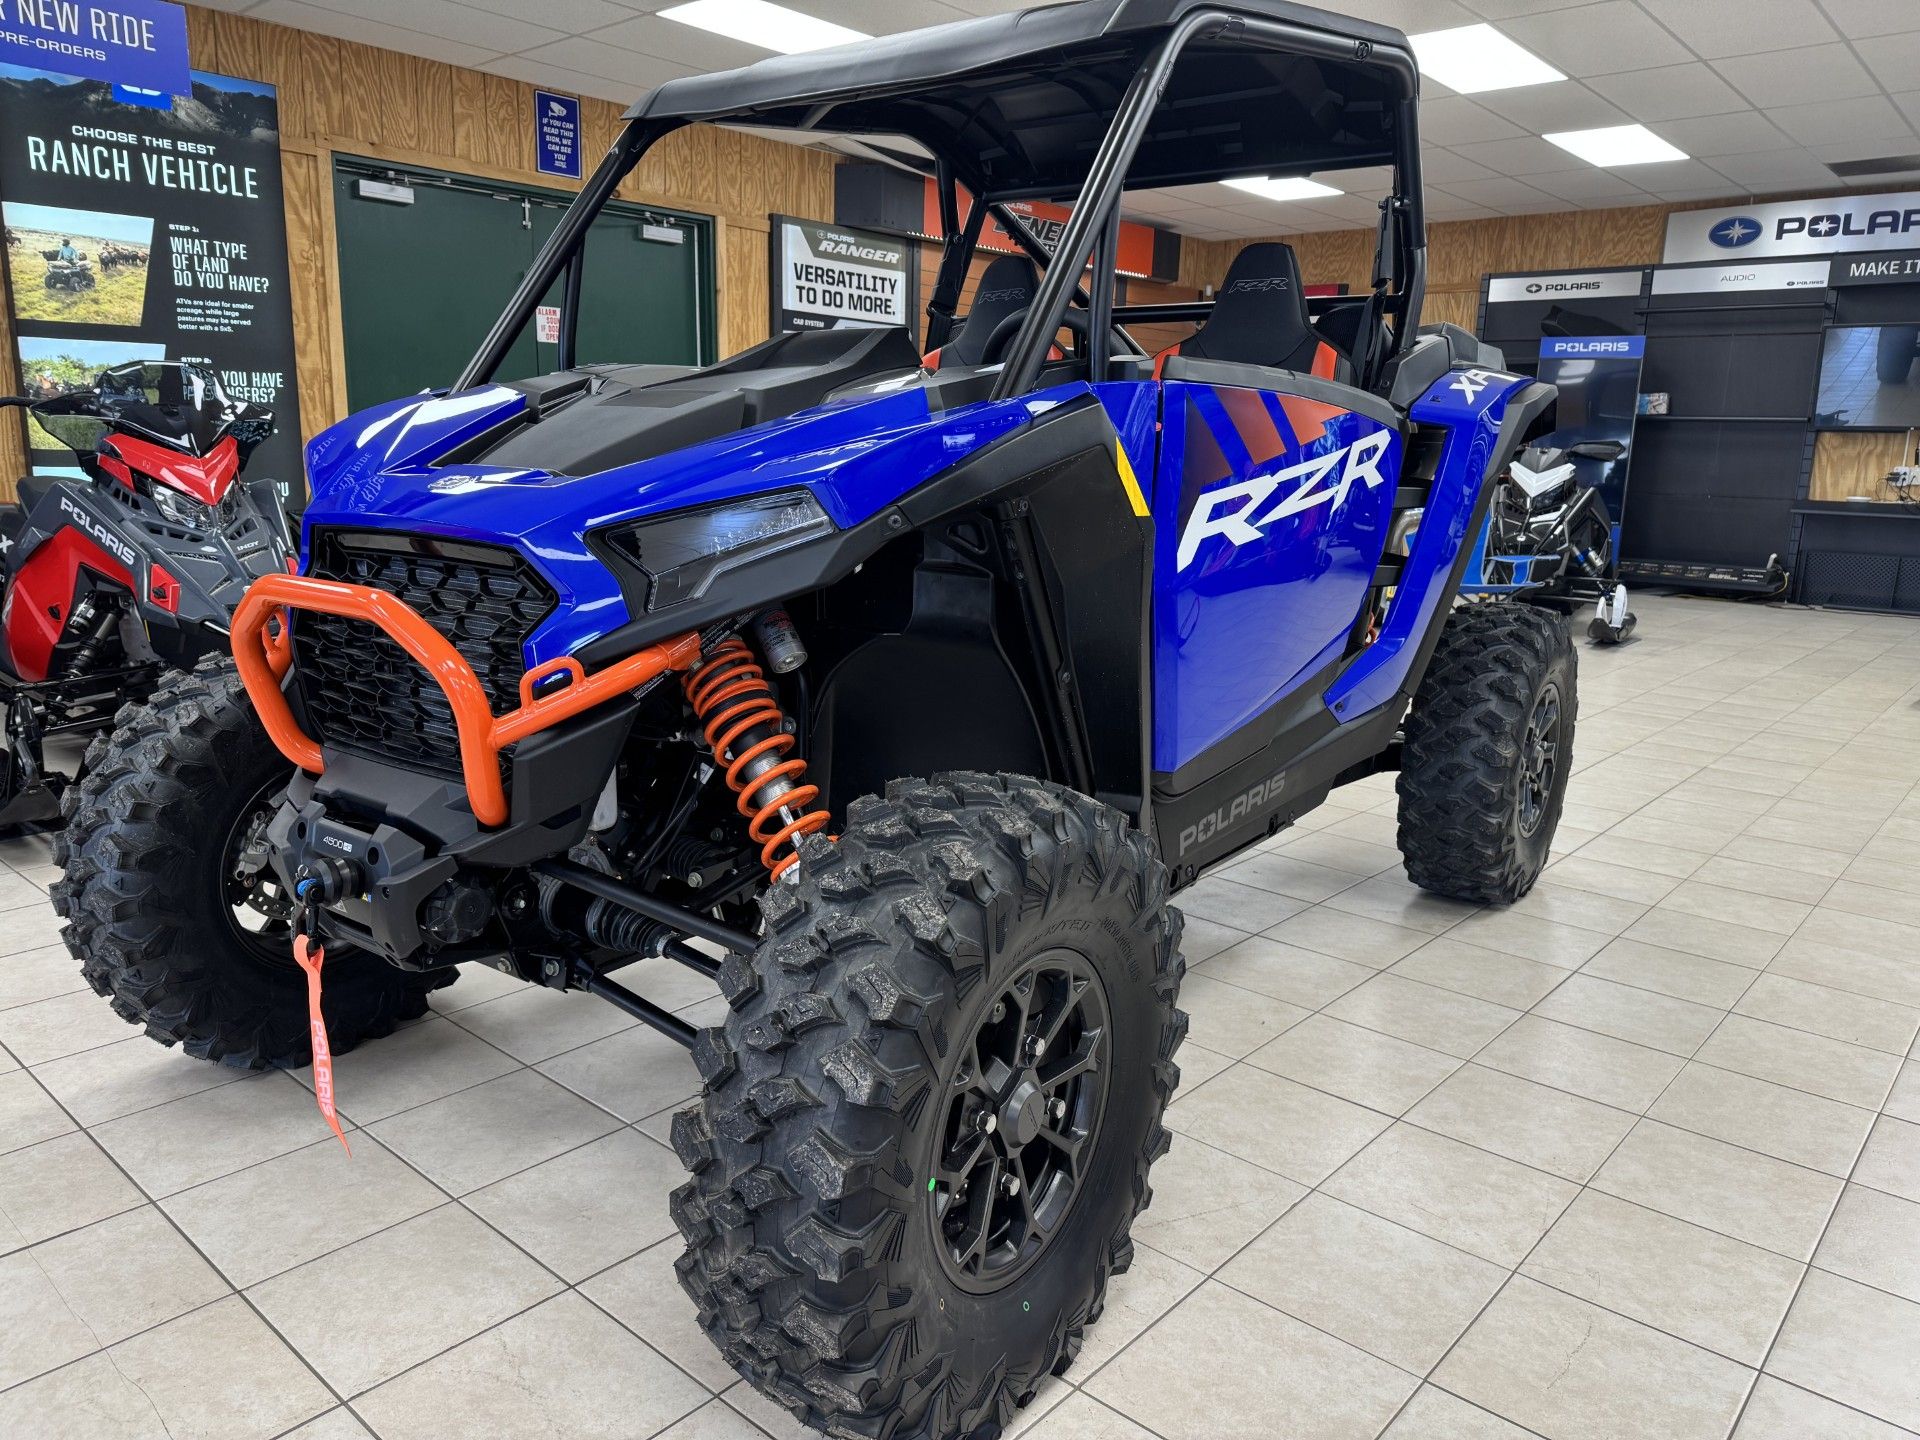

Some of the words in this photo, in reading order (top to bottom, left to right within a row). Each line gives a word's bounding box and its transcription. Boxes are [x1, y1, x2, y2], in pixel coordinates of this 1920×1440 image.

[17, 0, 80, 36] NEW
[90, 8, 157, 52] RIDE
[543, 125, 559, 134] READ
[560, 129, 574, 138] THIS
[550, 119, 561, 127] YOU
[561, 121, 574, 130] CAN
[71, 125, 138, 145] CHOOSE
[142, 135, 173, 150] THE
[177, 140, 216, 156] BEST
[547, 143, 560, 151] CAN
[560, 146, 572, 154] SEE
[562, 138, 572, 146] WE
[553, 153, 566, 161] YOU
[26, 136, 131, 183] RANCH
[141, 152, 259, 199] VEHICLE
[168, 223, 191, 232] STEP
[827, 232, 855, 244] POLARIS
[169, 236, 209, 256] WHAT
[213, 240, 248, 260] TYPE
[818, 239, 901, 264] RANGER
[172, 253, 190, 270] OF
[194, 255, 229, 274] LAND
[1849, 260, 1900, 277] MAKE
[173, 269, 193, 287] DO
[197, 271, 224, 289] YOU
[228, 274, 270, 293] HAVE?
[793, 262, 898, 295] VERSATILITY
[1545, 281, 1601, 292] POLARIS
[1720, 273, 1756, 283] AUDIO
[795, 285, 818, 305] TO
[822, 289, 844, 309] DO
[848, 293, 896, 316] MORE.
[537, 308, 557, 317] ALARM
[1554, 342, 1630, 352] POLARIS
[180, 356, 203, 364] STEP
[221, 370, 248, 387] YOU
[252, 372, 284, 388] HAVE
[1177, 428, 1392, 574] RZR
[60, 496, 136, 567] POLARIS
[1179, 769, 1286, 857] POLARIS
[322, 835, 344, 849] 4500
[311, 1020, 335, 1118] POLARIS
